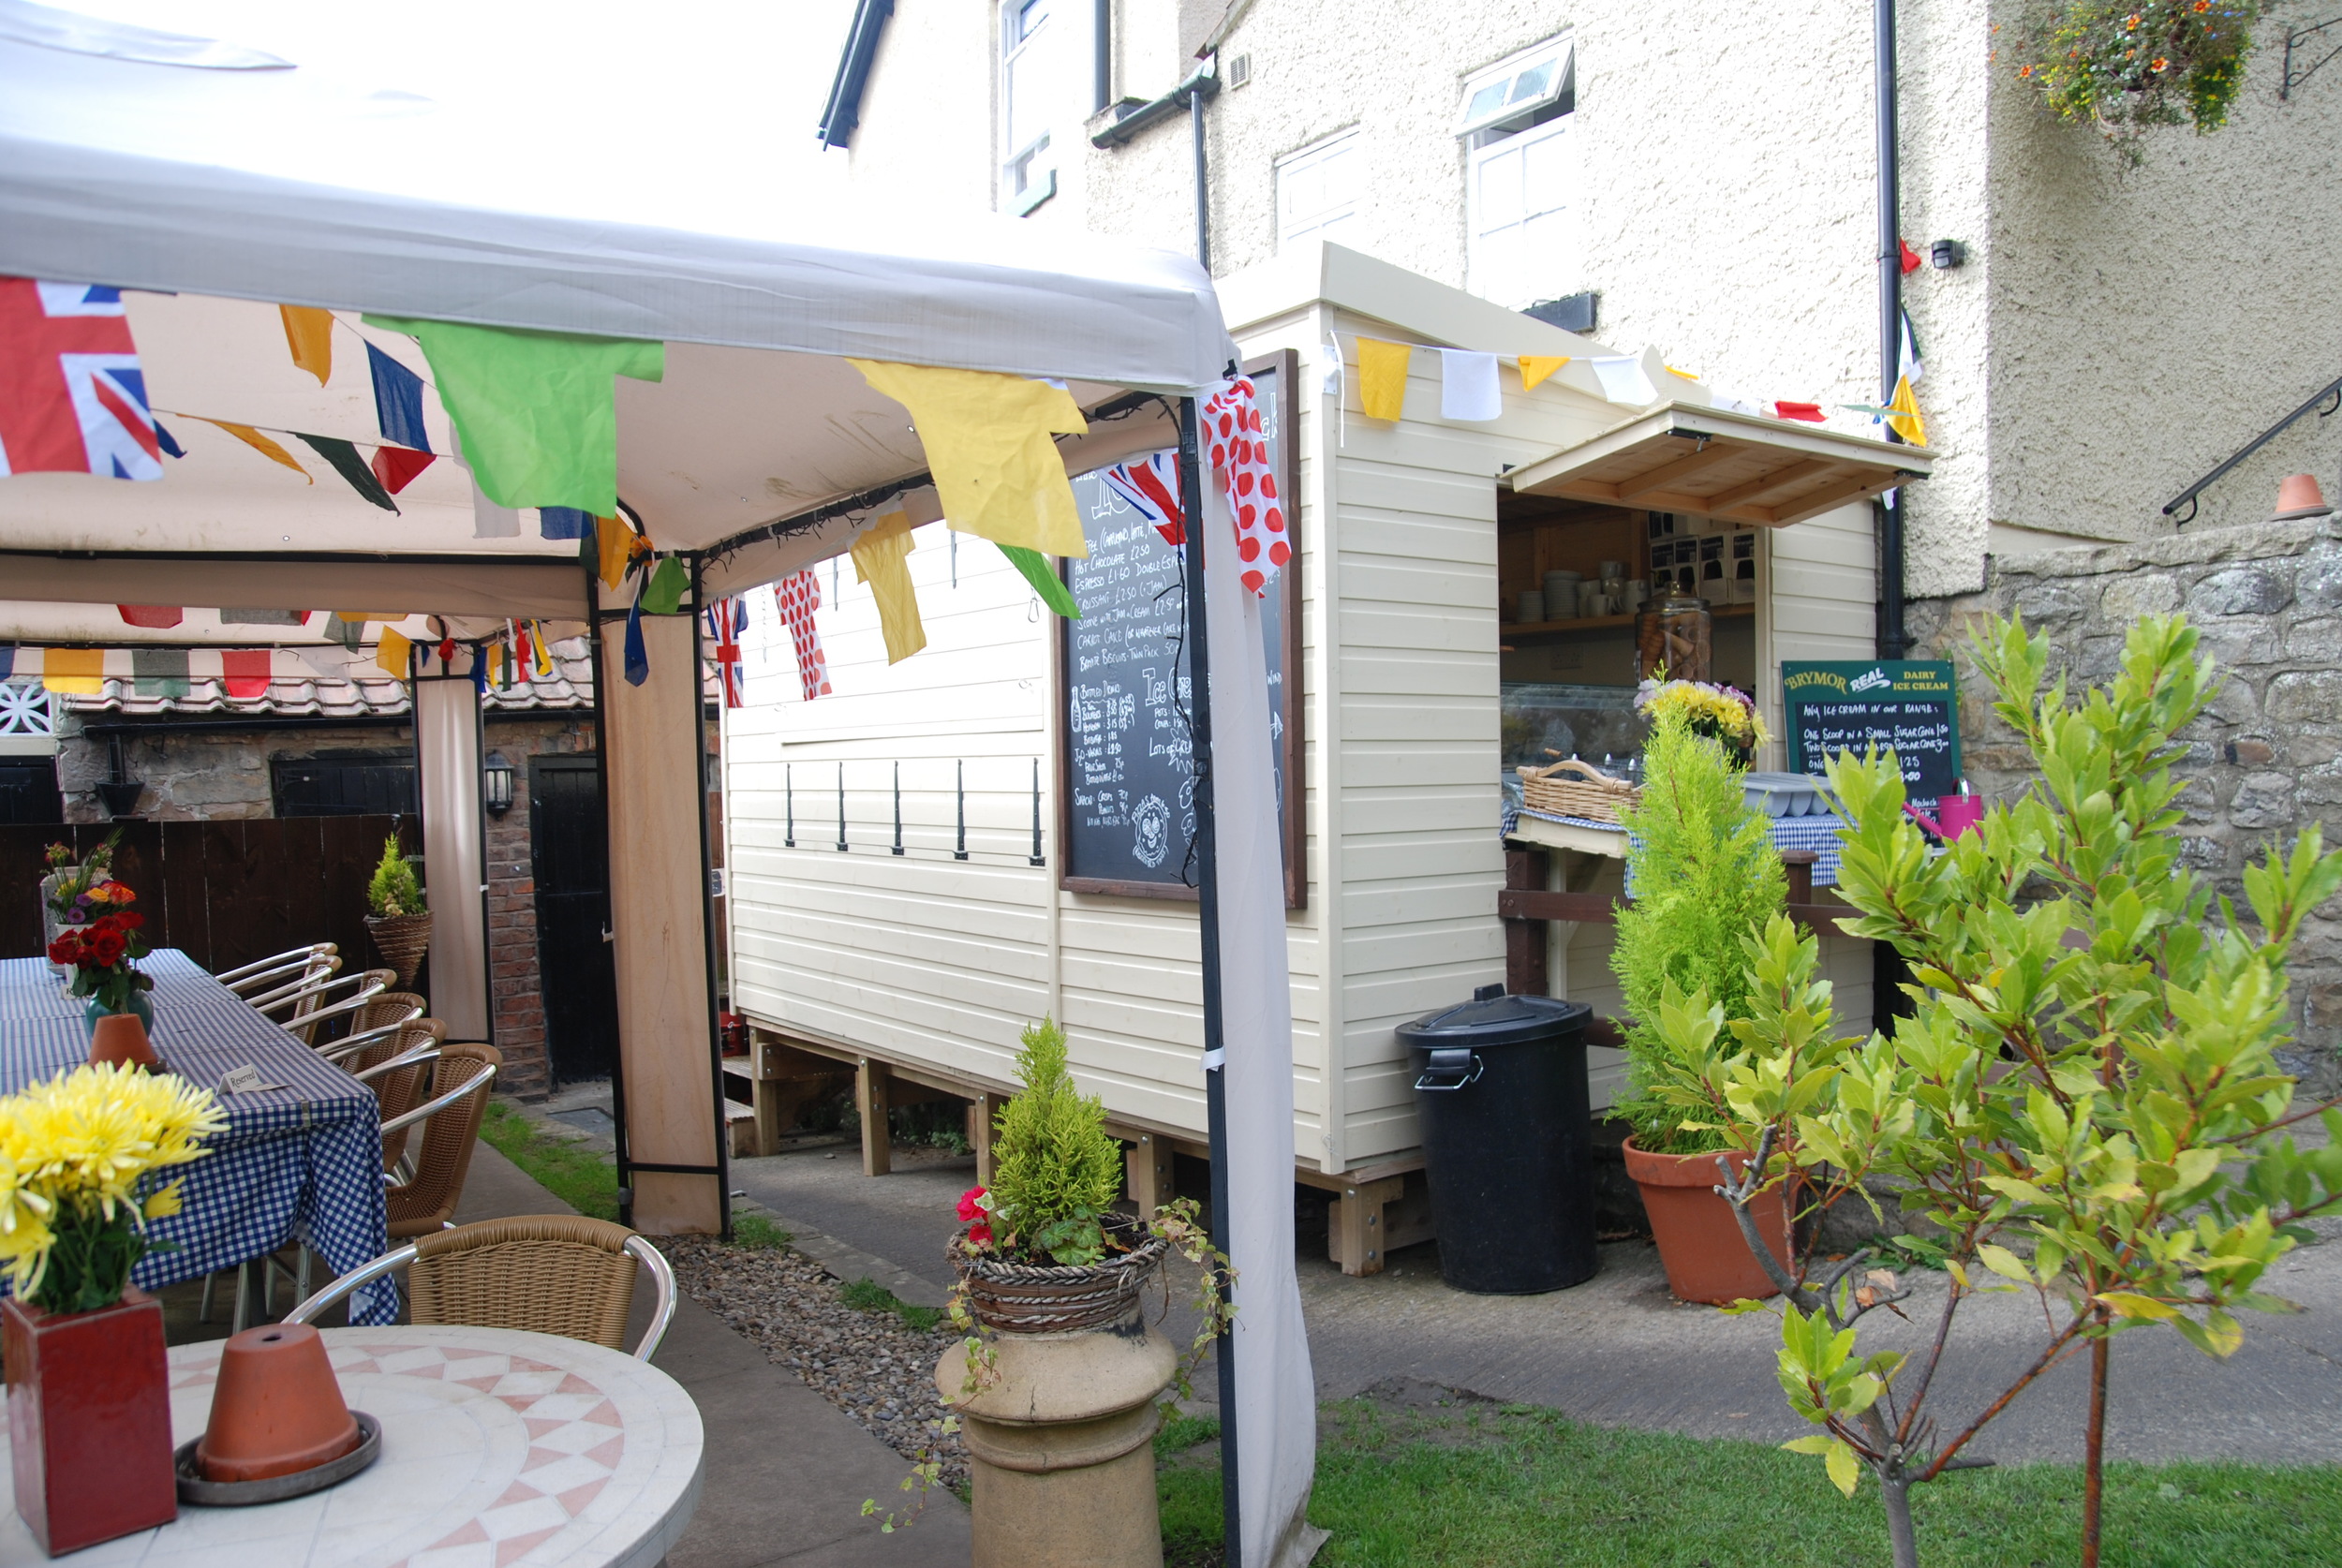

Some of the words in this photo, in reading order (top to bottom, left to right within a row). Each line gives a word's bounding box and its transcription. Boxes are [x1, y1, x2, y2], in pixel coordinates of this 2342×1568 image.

[1075, 559, 1089, 575] HOT
[1090, 554, 1125, 570] CHOCOLATE
[1075, 576, 1104, 594] ESPRESSO
[1135, 560, 1161, 576] DOUBLE
[1112, 608, 1126, 622] JAM
[1104, 628, 1123, 644] CAKE
[1784, 671, 1847, 695] BRYMOR
[1849, 667, 1886, 692] REAL
[1904, 671, 1936, 679] DAIRY
[1892, 682, 1910, 690] ICE
[1912, 682, 1949, 690] CREAM
[1823, 705, 1836, 716] ICE
[1838, 704, 1866, 714] CREAM
[1871, 704, 1881, 714] IN
[1803, 728, 1819, 740] ONE
[1822, 727, 1845, 740] SCOOP
[1846, 730, 1856, 739] IN
[1857, 730, 1863, 738] A
[1865, 726, 1891, 739] SMALL
[1894, 724, 1917, 737] SUGAR
[1918, 725, 1935, 737] CONE
[1149, 736, 1165, 757] LOTS
[1803, 741, 1820, 753] TWO
[1853, 742, 1862, 753] IN
[1894, 738, 1920, 750] SUGAR
[230, 1068, 256, 1087] Reserved
